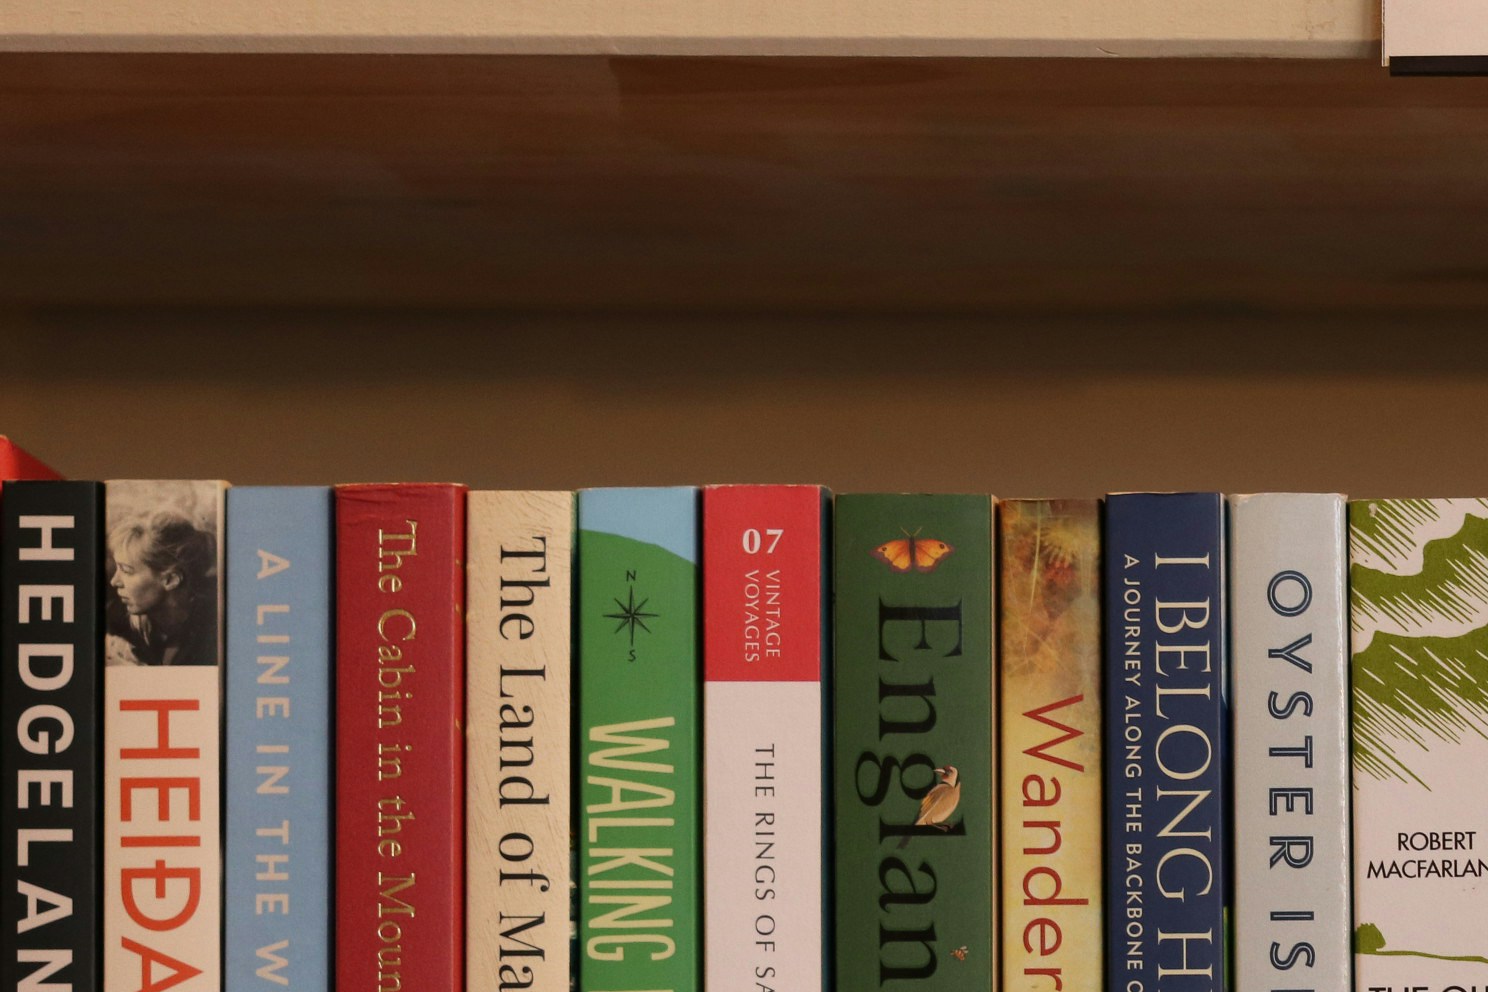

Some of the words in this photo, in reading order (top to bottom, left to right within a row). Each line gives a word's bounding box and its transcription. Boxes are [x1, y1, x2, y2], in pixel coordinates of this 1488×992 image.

[256, 549, 290, 580] A
[377, 520, 417, 594] The
[741, 528, 784, 554] 07
[1124, 555, 1139, 570] A
[1155, 552, 1209, 569] I
[499, 536, 550, 640] The
[744, 570, 759, 662] VOYAGES
[765, 570, 781, 658] VINTAGE
[256, 604, 290, 719] LINE
[377, 609, 416, 728] Cabin
[1124, 580, 1141, 687] JOURNEY
[499, 665, 550, 808] Land
[1125, 697, 1141, 779] ALONG
[1154, 596, 1213, 904] BELONG
[1267, 570, 1314, 869] OYSTER
[256, 744, 290, 794] IN
[378, 743, 412, 781] in
[755, 743, 775, 797] THE
[378, 799, 415, 857] the
[587, 716, 675, 961] WALKING
[1125, 788, 1142, 833] THE
[1398, 831, 1476, 852] ROBERT
[255, 820, 290, 915] THE
[498, 831, 550, 892] of
[755, 812, 775, 901] RINGS
[755, 914, 775, 952] OF
[1126, 844, 1143, 969] BACKBONE
